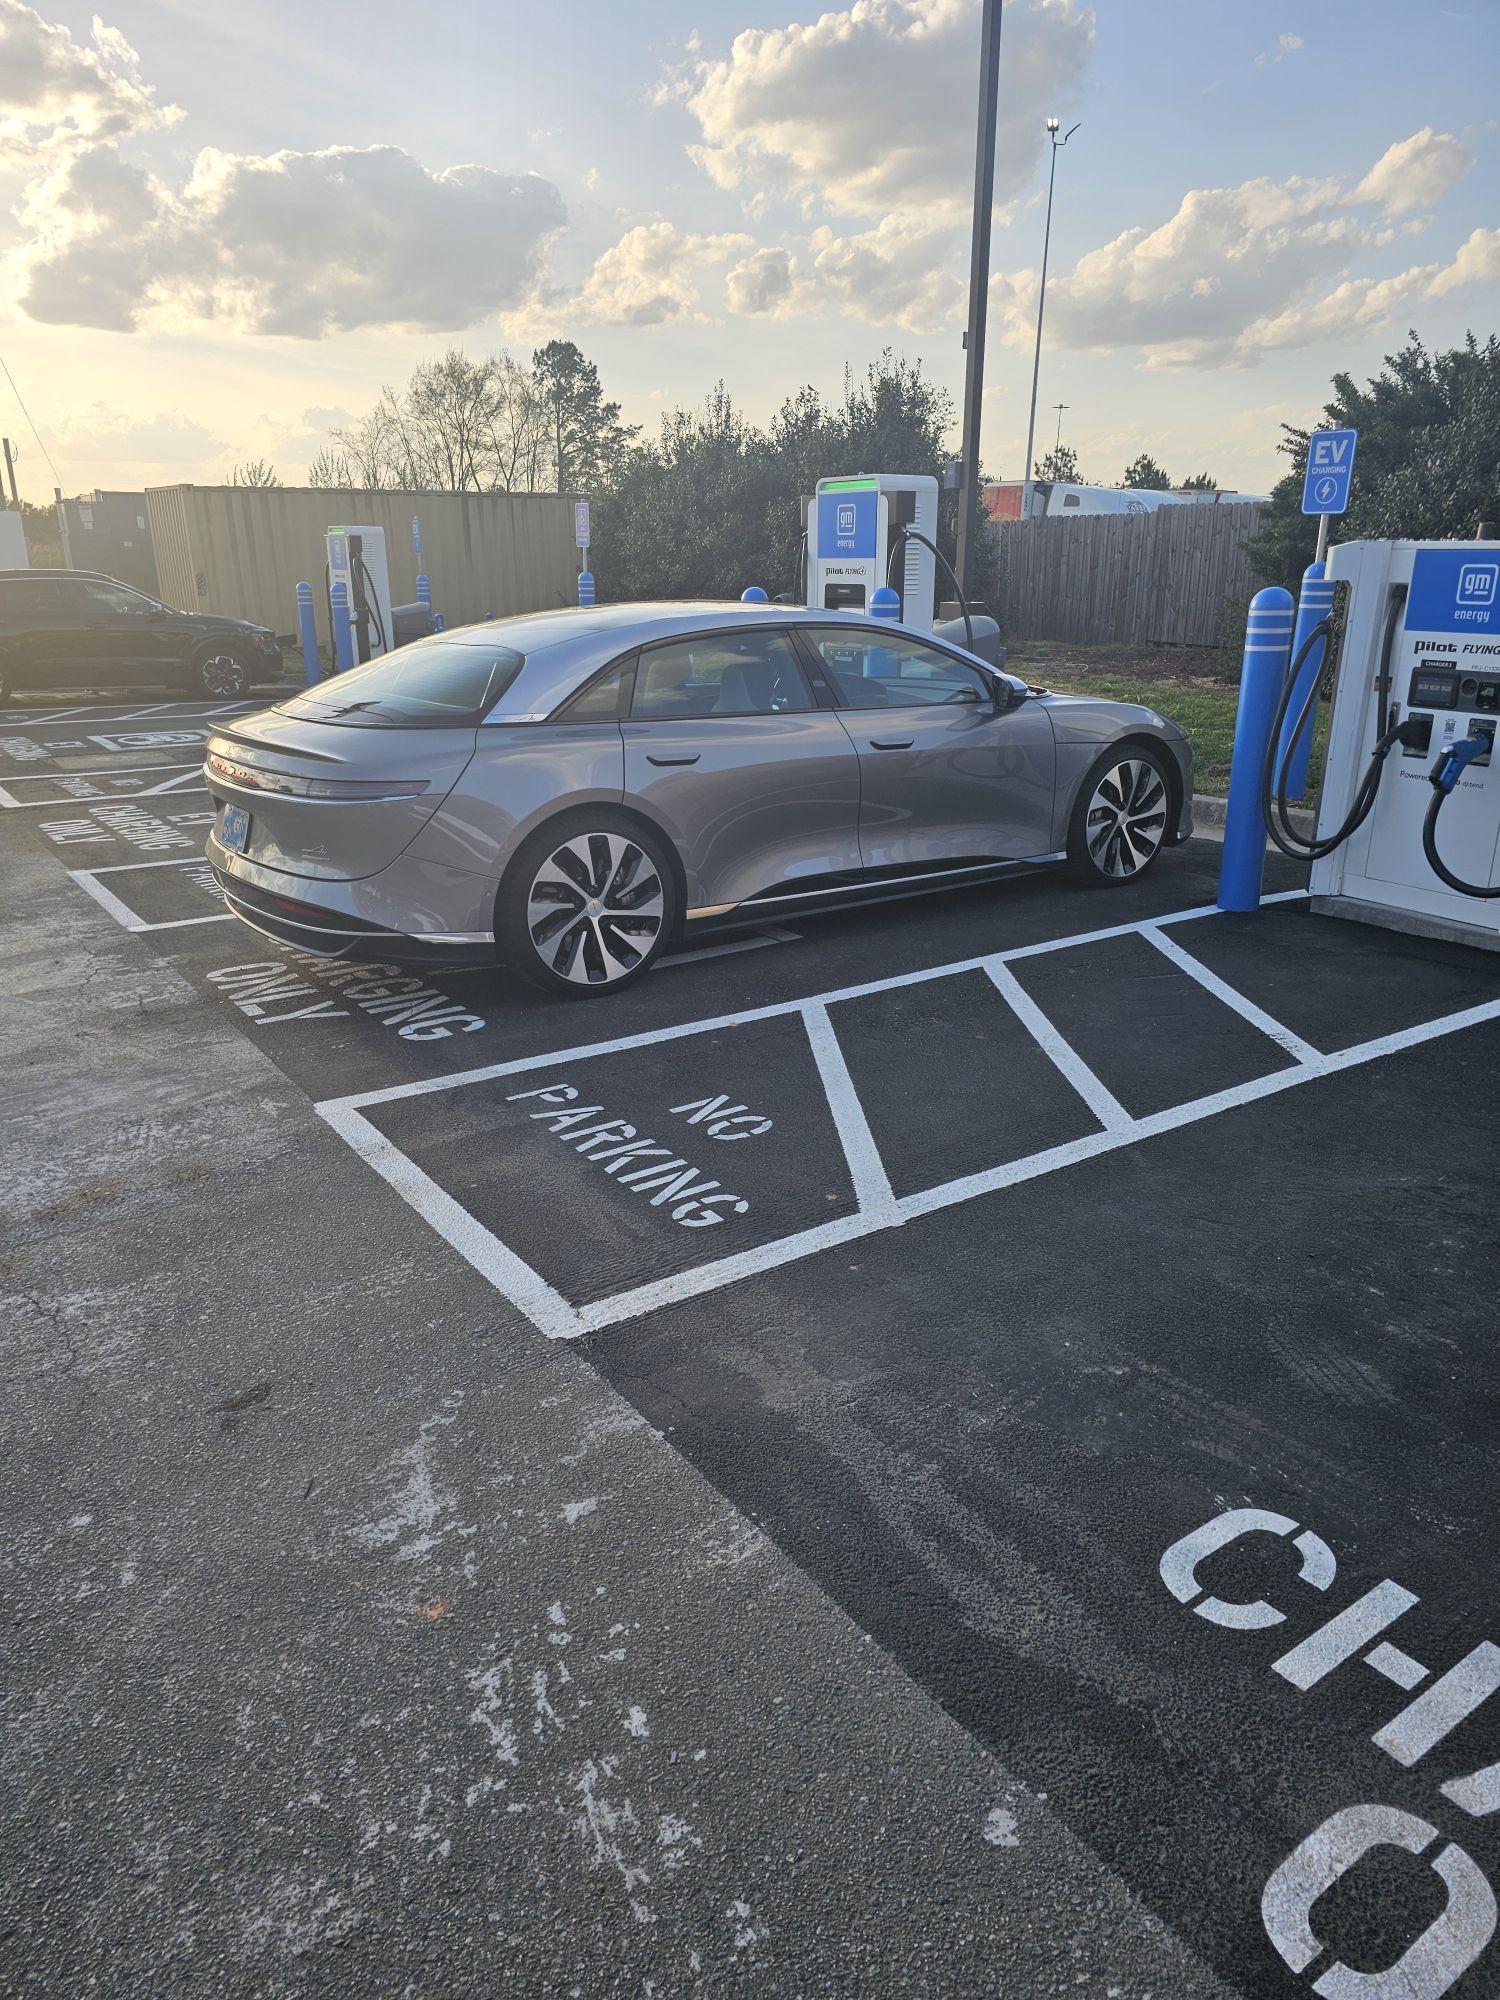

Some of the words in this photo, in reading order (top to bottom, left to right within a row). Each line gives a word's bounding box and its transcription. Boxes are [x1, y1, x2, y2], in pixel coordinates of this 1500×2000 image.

[1314, 440, 1349, 464] EV
[1311, 466, 1347, 475] CHARGING
[840, 511, 853, 527] gm
[837, 539, 855, 549] energy
[825, 567, 843, 577] pilot
[1465, 574, 1491, 595] gm
[1454, 610, 1490, 623] energy
[1413, 640, 1458, 654] pilot
[38, 819, 117, 845] ONLY
[88, 805, 195, 850] CHARGING
[206, 962, 350, 1025] ONLY
[669, 1094, 773, 1141] NO
[506, 1083, 749, 1227] PARKING
[1160, 1508, 1500, 1818] CH
